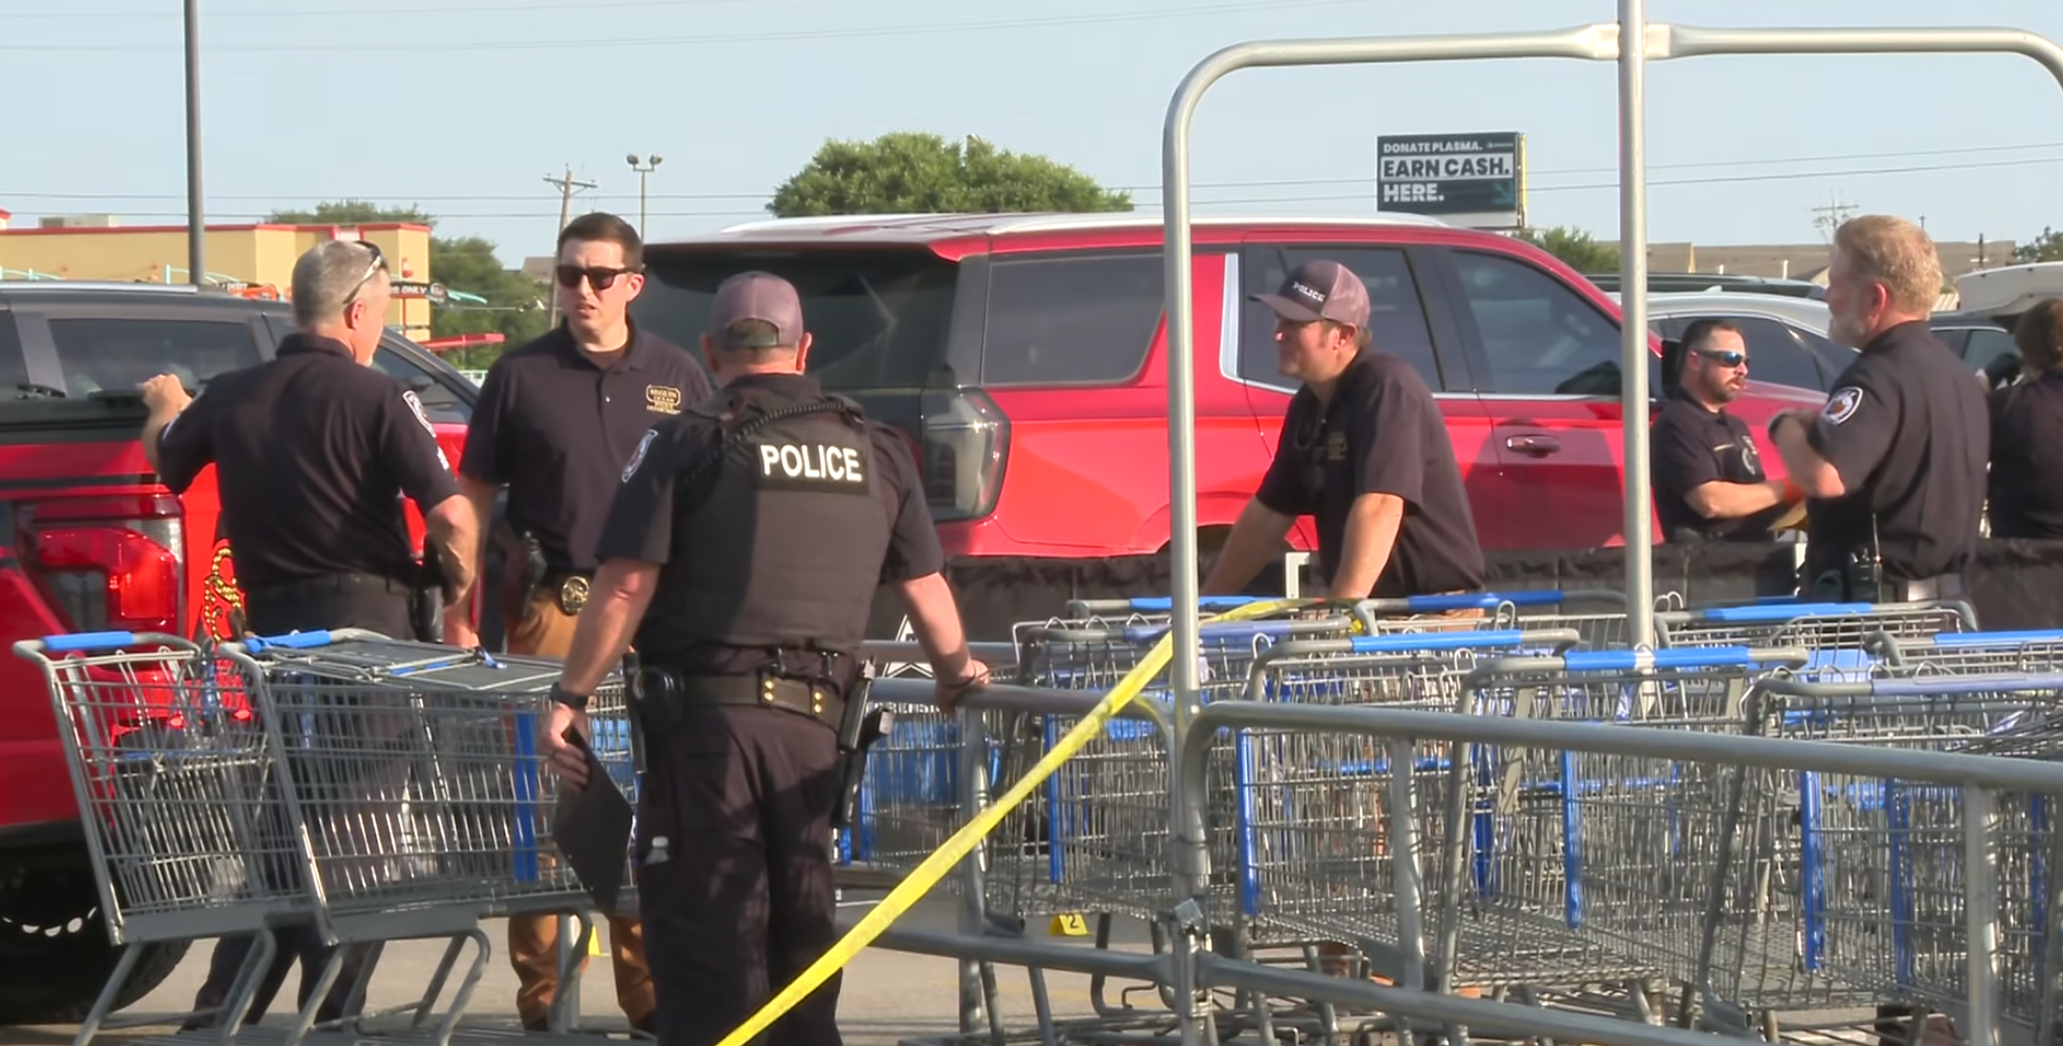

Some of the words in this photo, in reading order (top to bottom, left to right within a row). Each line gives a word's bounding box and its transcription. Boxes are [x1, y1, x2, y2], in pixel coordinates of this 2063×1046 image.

[1383, 142, 1430, 154] DONATE
[1432, 140, 1483, 152] PLASMA.
[1383, 159, 1440, 178] EARN
[1444, 157, 1511, 176] CASH.
[1383, 183, 1445, 202] HERE.
[1293, 281, 1325, 302] POLICE
[760, 444, 862, 482] POLICE
[1066, 912, 1080, 929] 2
